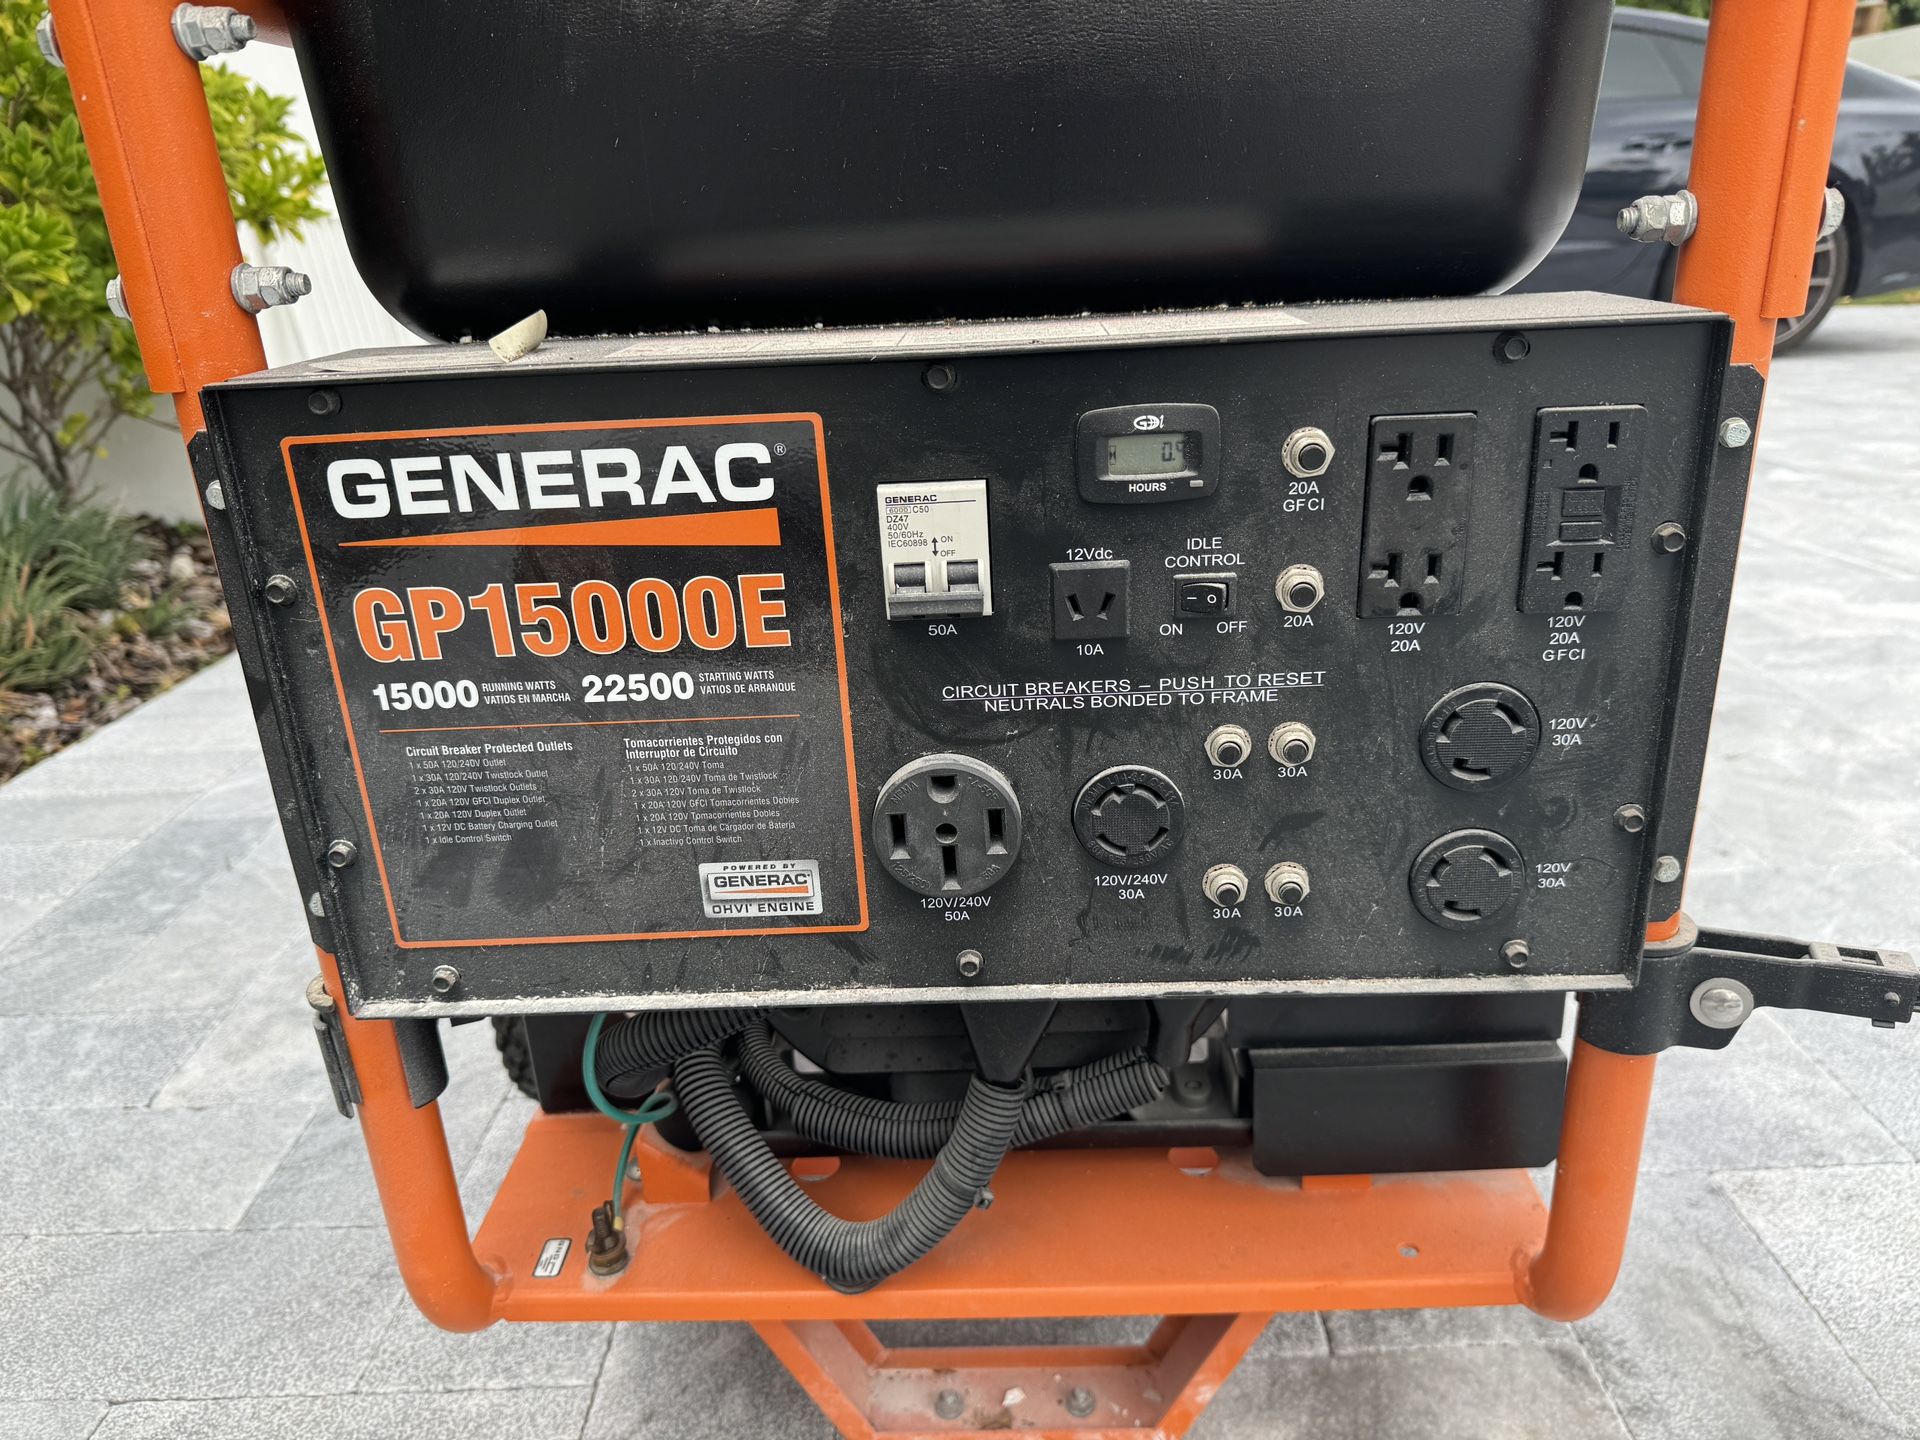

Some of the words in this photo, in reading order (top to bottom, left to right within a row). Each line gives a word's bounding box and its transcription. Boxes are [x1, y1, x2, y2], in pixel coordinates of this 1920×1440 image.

[1129, 483, 1166, 492] HOURS
[1289, 481, 1319, 495] 20A
[885, 495, 937, 503] GENERAC
[1283, 498, 1325, 512] GFCI
[913, 505, 930, 513] C50
[886, 515, 909, 523] DZ47
[888, 531, 924, 539] 50/60Hz
[888, 539, 928, 548] IEC60898
[1187, 537, 1222, 550] IDLE
[1066, 547, 1113, 561] 12Vdc
[1165, 553, 1245, 568] CONTROL
[352, 572, 792, 663] GP15000E
[1284, 615, 1314, 627] 20A
[1547, 616, 1586, 628] 120V
[928, 624, 958, 635] 50A
[1160, 624, 1183, 635] ON
[1216, 621, 1248, 634] OFF
[1387, 622, 1426, 635] 120V
[1550, 632, 1580, 644] 20A
[1076, 644, 1104, 656] 10A
[1390, 640, 1420, 652] 20A
[1542, 648, 1586, 662] GFCI
[699, 671, 741, 682] STARTING
[743, 670, 774, 680] WATTS
[482, 682, 523, 692] RUNNING
[525, 680, 556, 691] WATTS
[582, 671, 694, 703] 22500
[699, 684, 732, 695] VATIOS
[734, 684, 746, 693] DE
[748, 682, 796, 693] ARRANQUE
[942, 683, 1019, 699] CIRCUIT
[1025, 679, 1131, 695] BREAKERS
[1159, 676, 1214, 690] PUSH
[1223, 674, 1255, 688] TO
[1257, 671, 1327, 686] RESET
[372, 680, 480, 711] 15000
[484, 694, 516, 705] VATIOS
[518, 694, 531, 704] EN
[532, 693, 571, 703] MARCHA
[984, 696, 1086, 712] NEUTRALS
[1091, 694, 1173, 708] BONDED
[1178, 692, 1205, 705] TO
[1211, 689, 1278, 703] FRAME
[1549, 717, 1587, 729] 120V
[623, 736, 704, 749] Tomacorrientes
[707, 735, 761, 747] Protegidos
[764, 734, 783, 743] con
[1552, 734, 1582, 746] 30A
[406, 745, 439, 757] Circuit
[442, 744, 481, 755] Breaker
[485, 742, 534, 753] Protected
[537, 741, 573, 752] Outlets
[625, 748, 680, 760] Interruptor
[683, 747, 696, 757] de
[699, 746, 738, 756] Circuito
[423, 760, 439, 769] 50A
[442, 759, 480, 768] 120/240V
[483, 758, 506, 767] Outlet
[642, 763, 659, 772] 50A
[702, 760, 725, 769] Toma
[426, 773, 442, 782] 30A
[445, 772, 483, 781] 120/240V
[485, 770, 523, 780] Twistlock
[525, 769, 549, 778] Outlet
[644, 776, 660, 784] 30A
[704, 774, 726, 782] Toma
[728, 772, 738, 780] de
[740, 771, 778, 780] Twistlock
[1213, 769, 1243, 780] 30A
[1277, 766, 1307, 777] 30A
[428, 785, 445, 794] 30A
[447, 784, 467, 793] 120V
[469, 784, 507, 793] Twistlock
[509, 782, 537, 791] Outlets
[646, 788, 662, 797] 30A
[664, 787, 685, 796] 120V
[687, 786, 710, 795] Toma
[712, 786, 722, 794] de
[724, 784, 761, 794] Twistlock
[431, 798, 447, 807] 20A
[449, 798, 470, 806] 120V
[472, 797, 491, 805] GFCI
[494, 796, 521, 806] Duplex
[522, 795, 546, 804] Outlet
[648, 801, 664, 809] 20A
[666, 800, 687, 809] 120V
[710, 797, 770, 807] Tomacorrientes
[772, 796, 800, 804] Dobles
[434, 811, 450, 820] 20A
[452, 810, 472, 819] 120V
[475, 809, 502, 819] Duplex
[504, 808, 527, 817] Outlet
[650, 813, 666, 822] 20A
[668, 812, 689, 821] 120V
[691, 810, 751, 820] Tomacorrientes
[753, 809, 780, 818] Dobles
[437, 823, 452, 832] 12V
[454, 822, 466, 831] DC
[468, 821, 496, 832] Battery
[498, 820, 533, 830] Charging
[535, 819, 558, 828] Outlet
[652, 825, 667, 834] 12V
[669, 824, 681, 833] DC
[684, 823, 705, 832] Toma
[708, 823, 717, 831] de
[719, 821, 755, 832] Cargador
[757, 820, 766, 830] de
[439, 835, 454, 844] Idle
[455, 833, 484, 843] Control
[485, 833, 512, 842] Switch
[686, 835, 714, 845] Control
[716, 834, 742, 843] Switch
[1536, 862, 1571, 874] 120V
[714, 873, 808, 888] GENERAC
[1094, 873, 1168, 887] 120V/240V
[1537, 878, 1566, 888] 30A
[1118, 889, 1145, 900] 30A
[758, 902, 814, 912] ENGINE
[920, 896, 991, 909] 120V/240V
[944, 910, 970, 922] 50A
[1212, 908, 1241, 919] 30A
[1274, 906, 1303, 918] 30A
